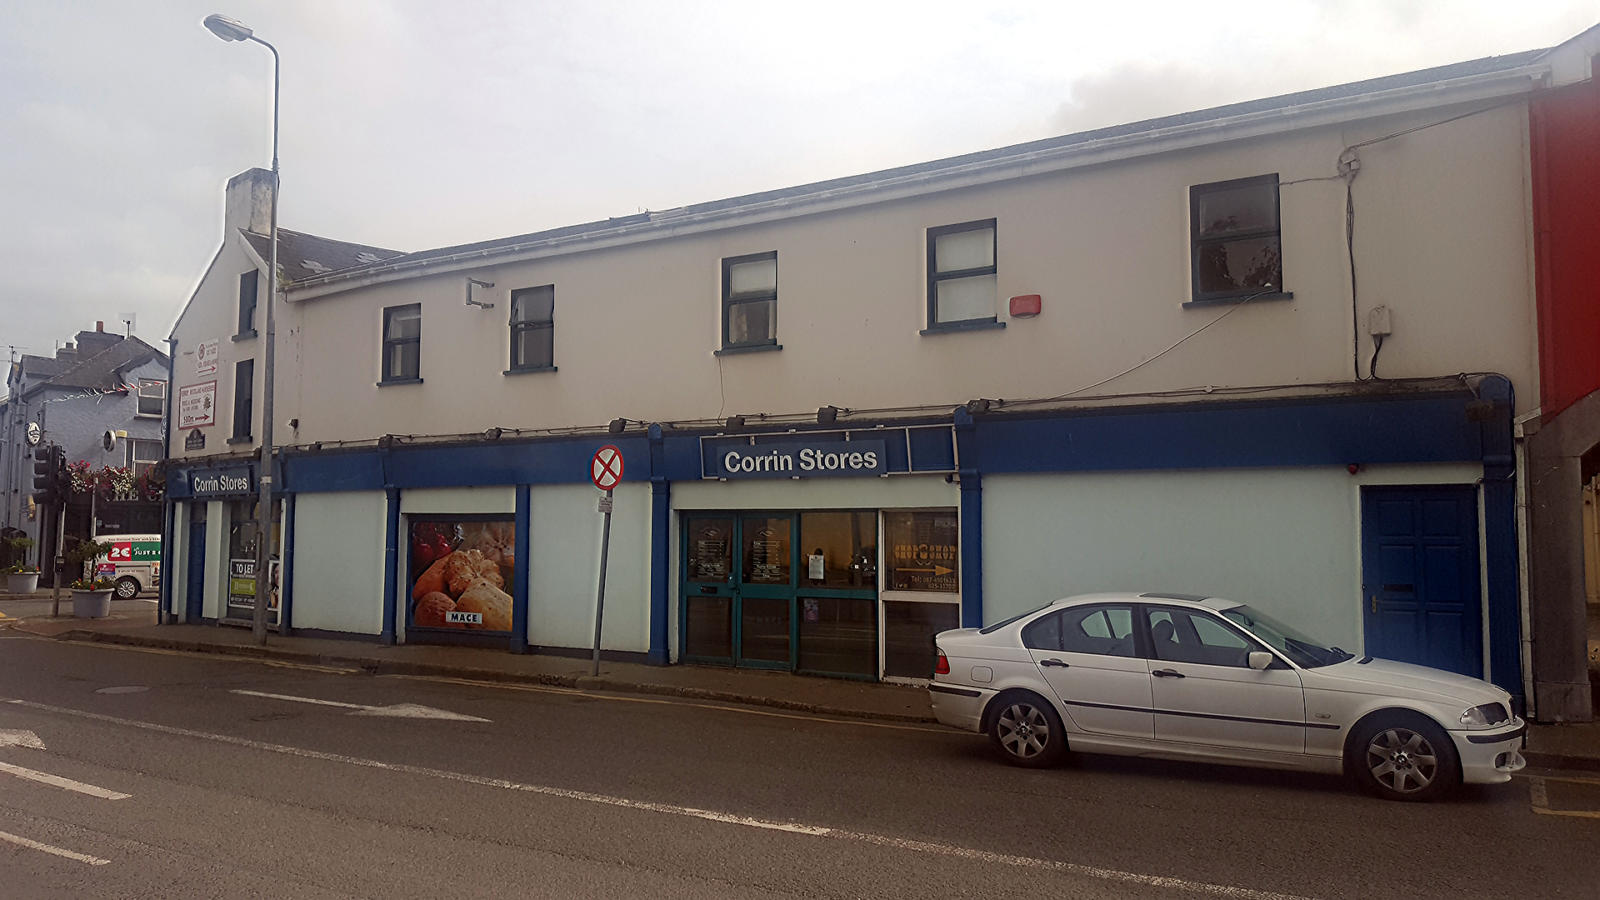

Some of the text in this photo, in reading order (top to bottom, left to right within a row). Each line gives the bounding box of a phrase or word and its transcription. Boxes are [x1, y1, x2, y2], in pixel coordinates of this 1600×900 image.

[725, 448, 878, 473] Corrin Stores
[194, 475, 248, 492] Corrin Stores
[236, 564, 254, 575] TO LET
[451, 613, 478, 622] MACE
